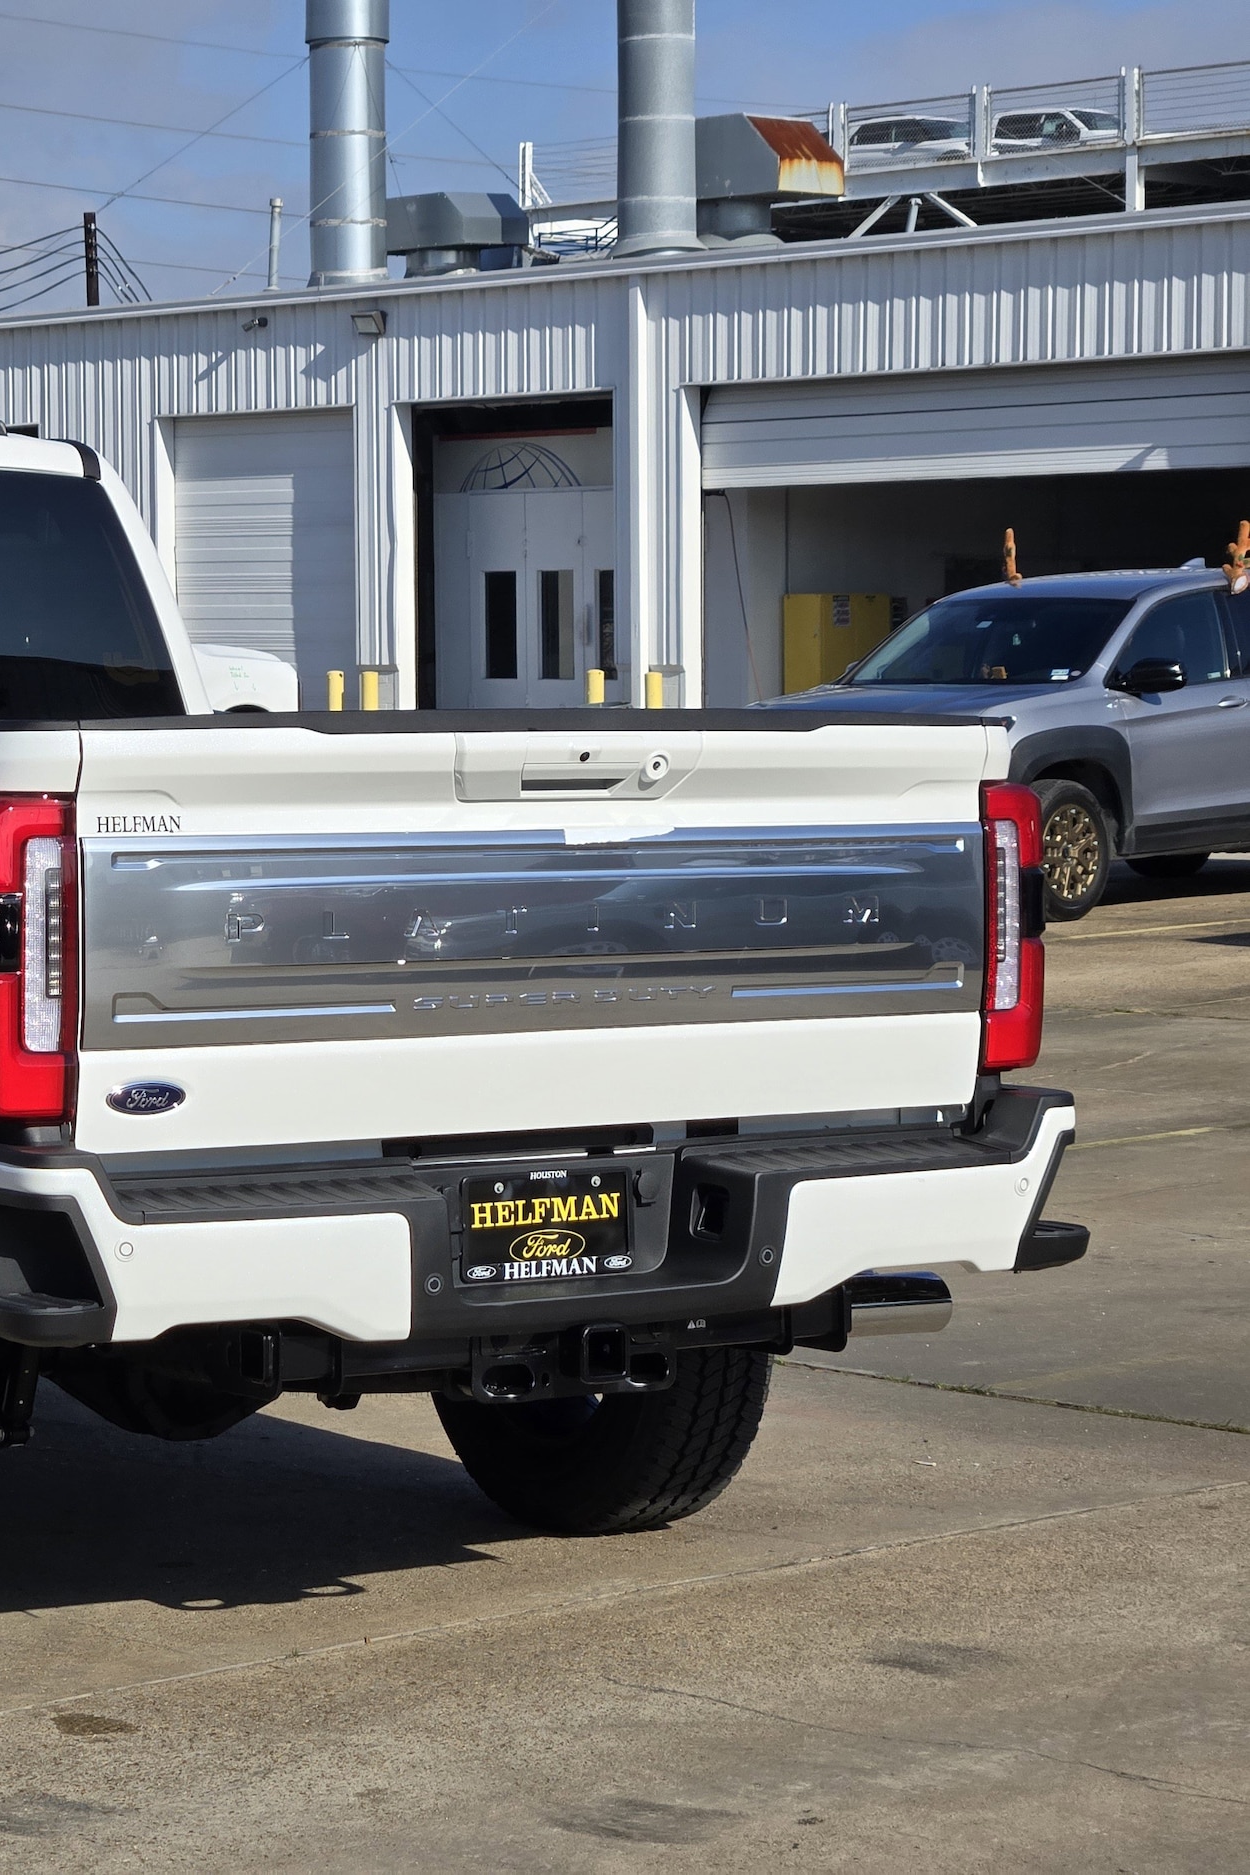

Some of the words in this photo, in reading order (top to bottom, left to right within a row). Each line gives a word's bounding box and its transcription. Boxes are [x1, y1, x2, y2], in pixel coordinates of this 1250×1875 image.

[96, 815, 182, 833] HELFMAN
[225, 895, 880, 943] PLATINUM
[413, 988, 582, 1011] SUPER
[594, 985, 717, 1004] DUTY
[126, 1088, 170, 1109] Ford
[529, 1169, 568, 1181] HOUSTON
[470, 1192, 621, 1229] HELFMAN
[522, 1233, 571, 1259] Ford
[503, 1256, 599, 1280] HELFMAN
